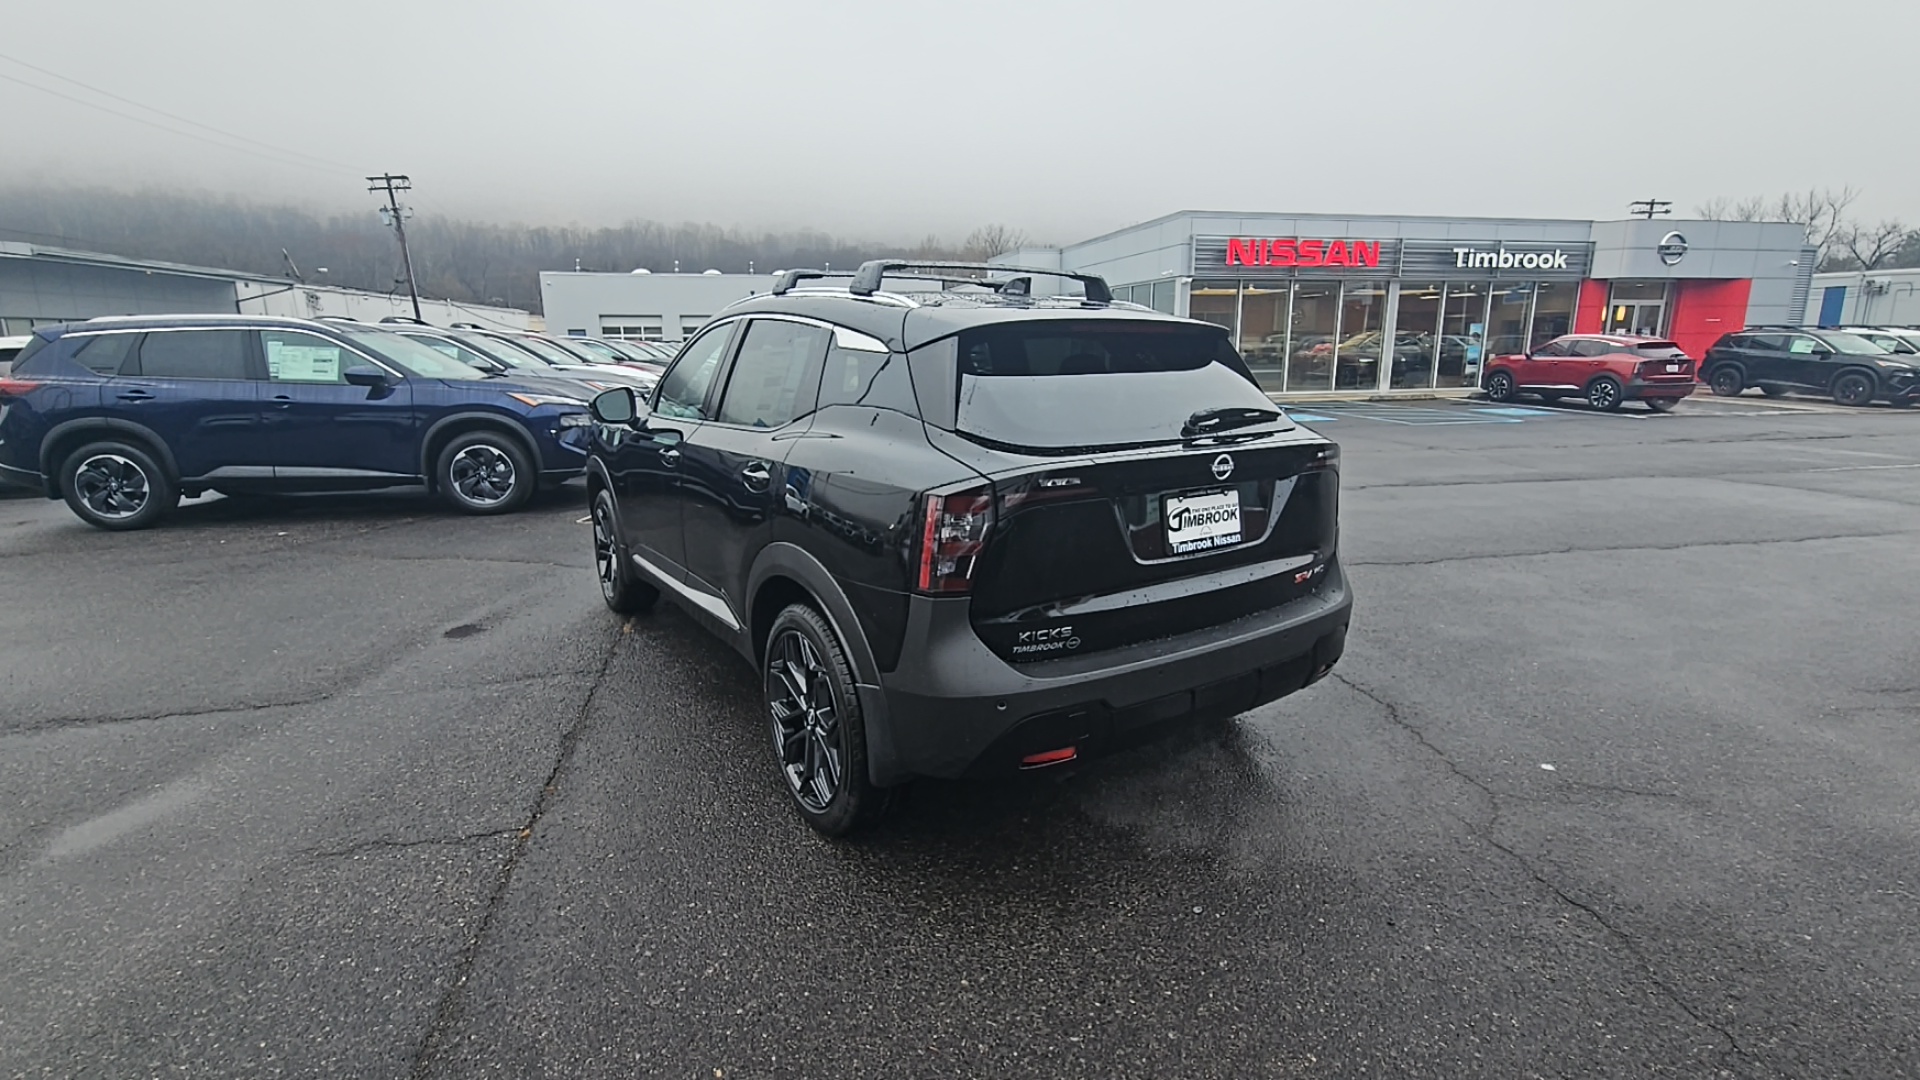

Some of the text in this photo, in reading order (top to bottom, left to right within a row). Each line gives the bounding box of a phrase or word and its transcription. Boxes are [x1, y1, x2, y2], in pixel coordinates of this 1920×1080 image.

[1226, 238, 1380, 267] NISSAN
[1453, 247, 1568, 269] Timbrook
[1169, 507, 1238, 532] TIMBROOK
[1172, 534, 1241, 554] Timbrook Nissan
[1019, 626, 1072, 642] KICKS
[1013, 641, 1066, 653] TIMBROOK
